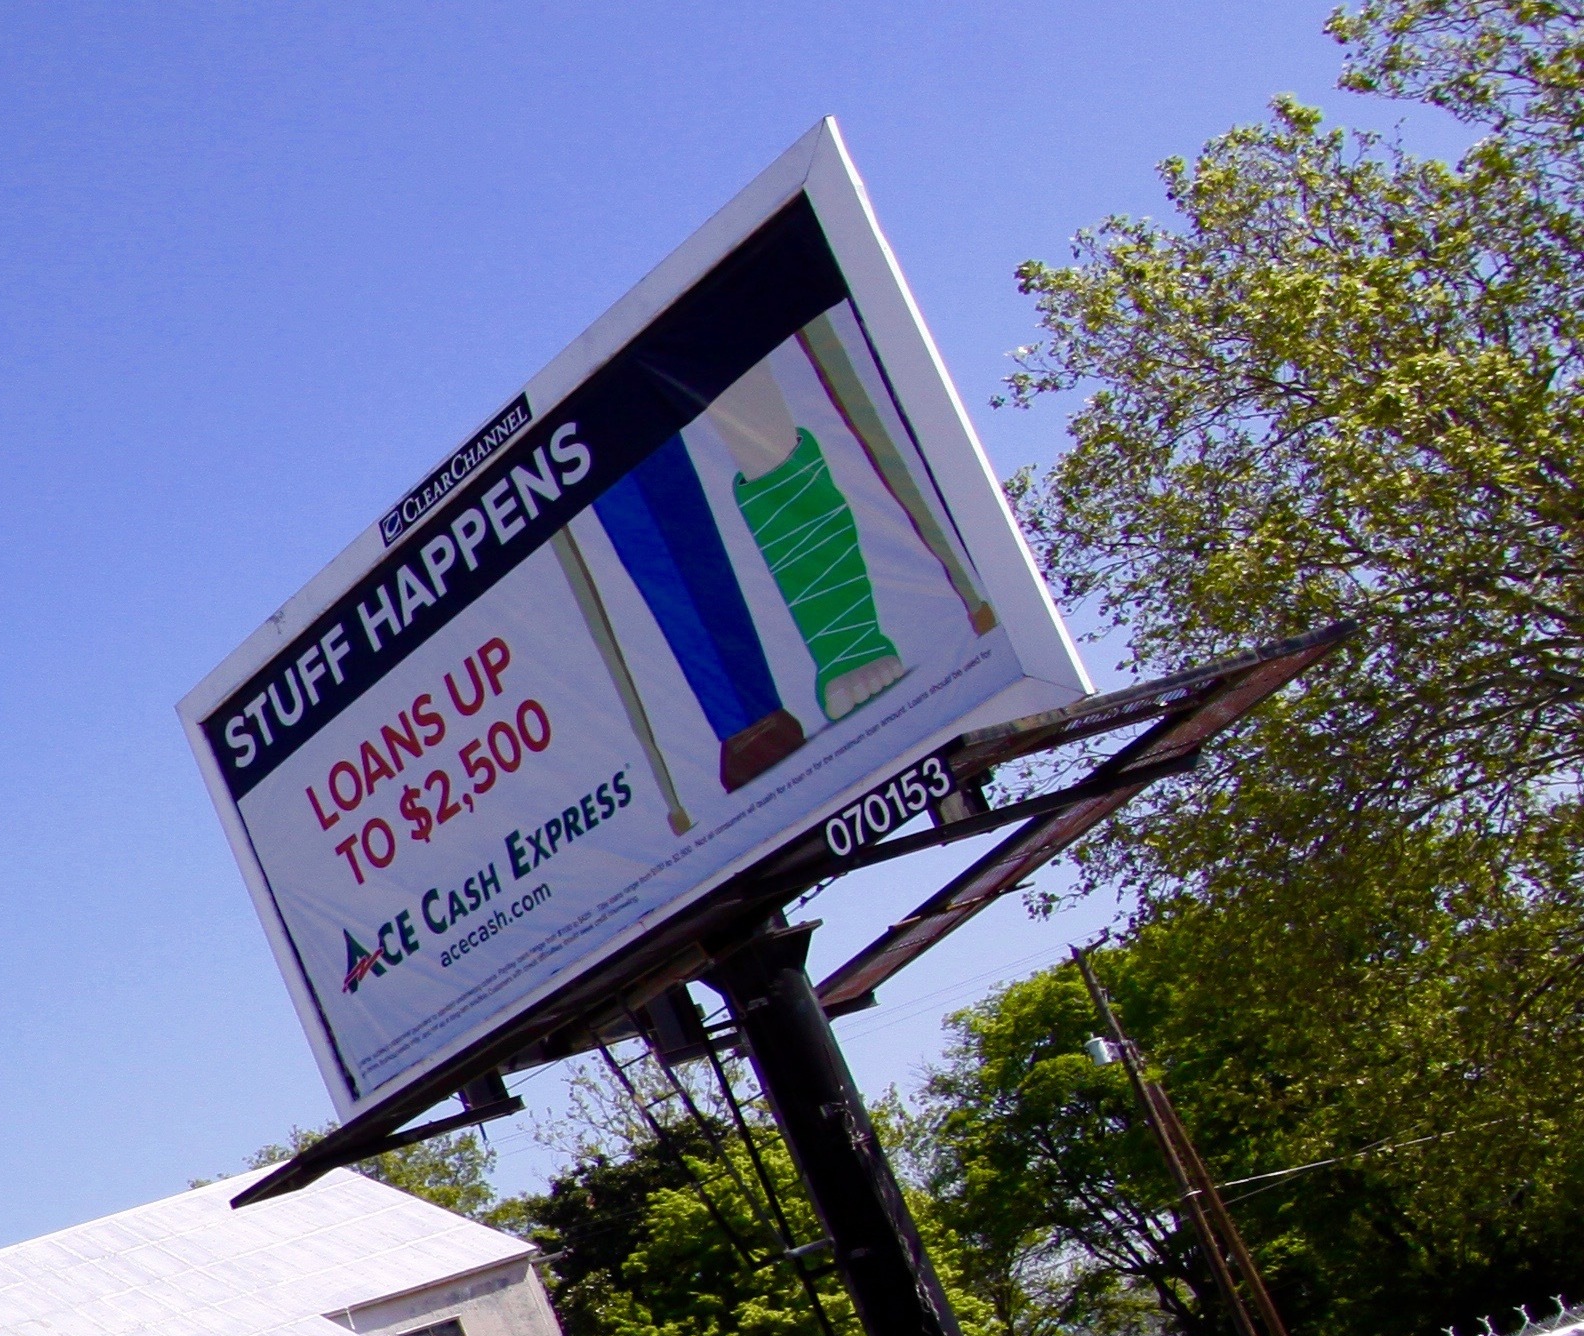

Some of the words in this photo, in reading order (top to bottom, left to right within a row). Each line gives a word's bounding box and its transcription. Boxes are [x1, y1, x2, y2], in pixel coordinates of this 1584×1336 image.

[223, 623, 352, 768] STUFF
[355, 421, 593, 653] HAPPENS
[305, 693, 447, 832] LOANS
[443, 637, 512, 717] UP
[335, 817, 396, 886] TO
[398, 699, 552, 843] $2,500
[825, 757, 951, 857] 070153
[342, 910, 421, 994] ACE
[420, 863, 502, 935] CASH
[503, 769, 633, 881] EXPRESS
[440, 883, 552, 968] acecash.com
